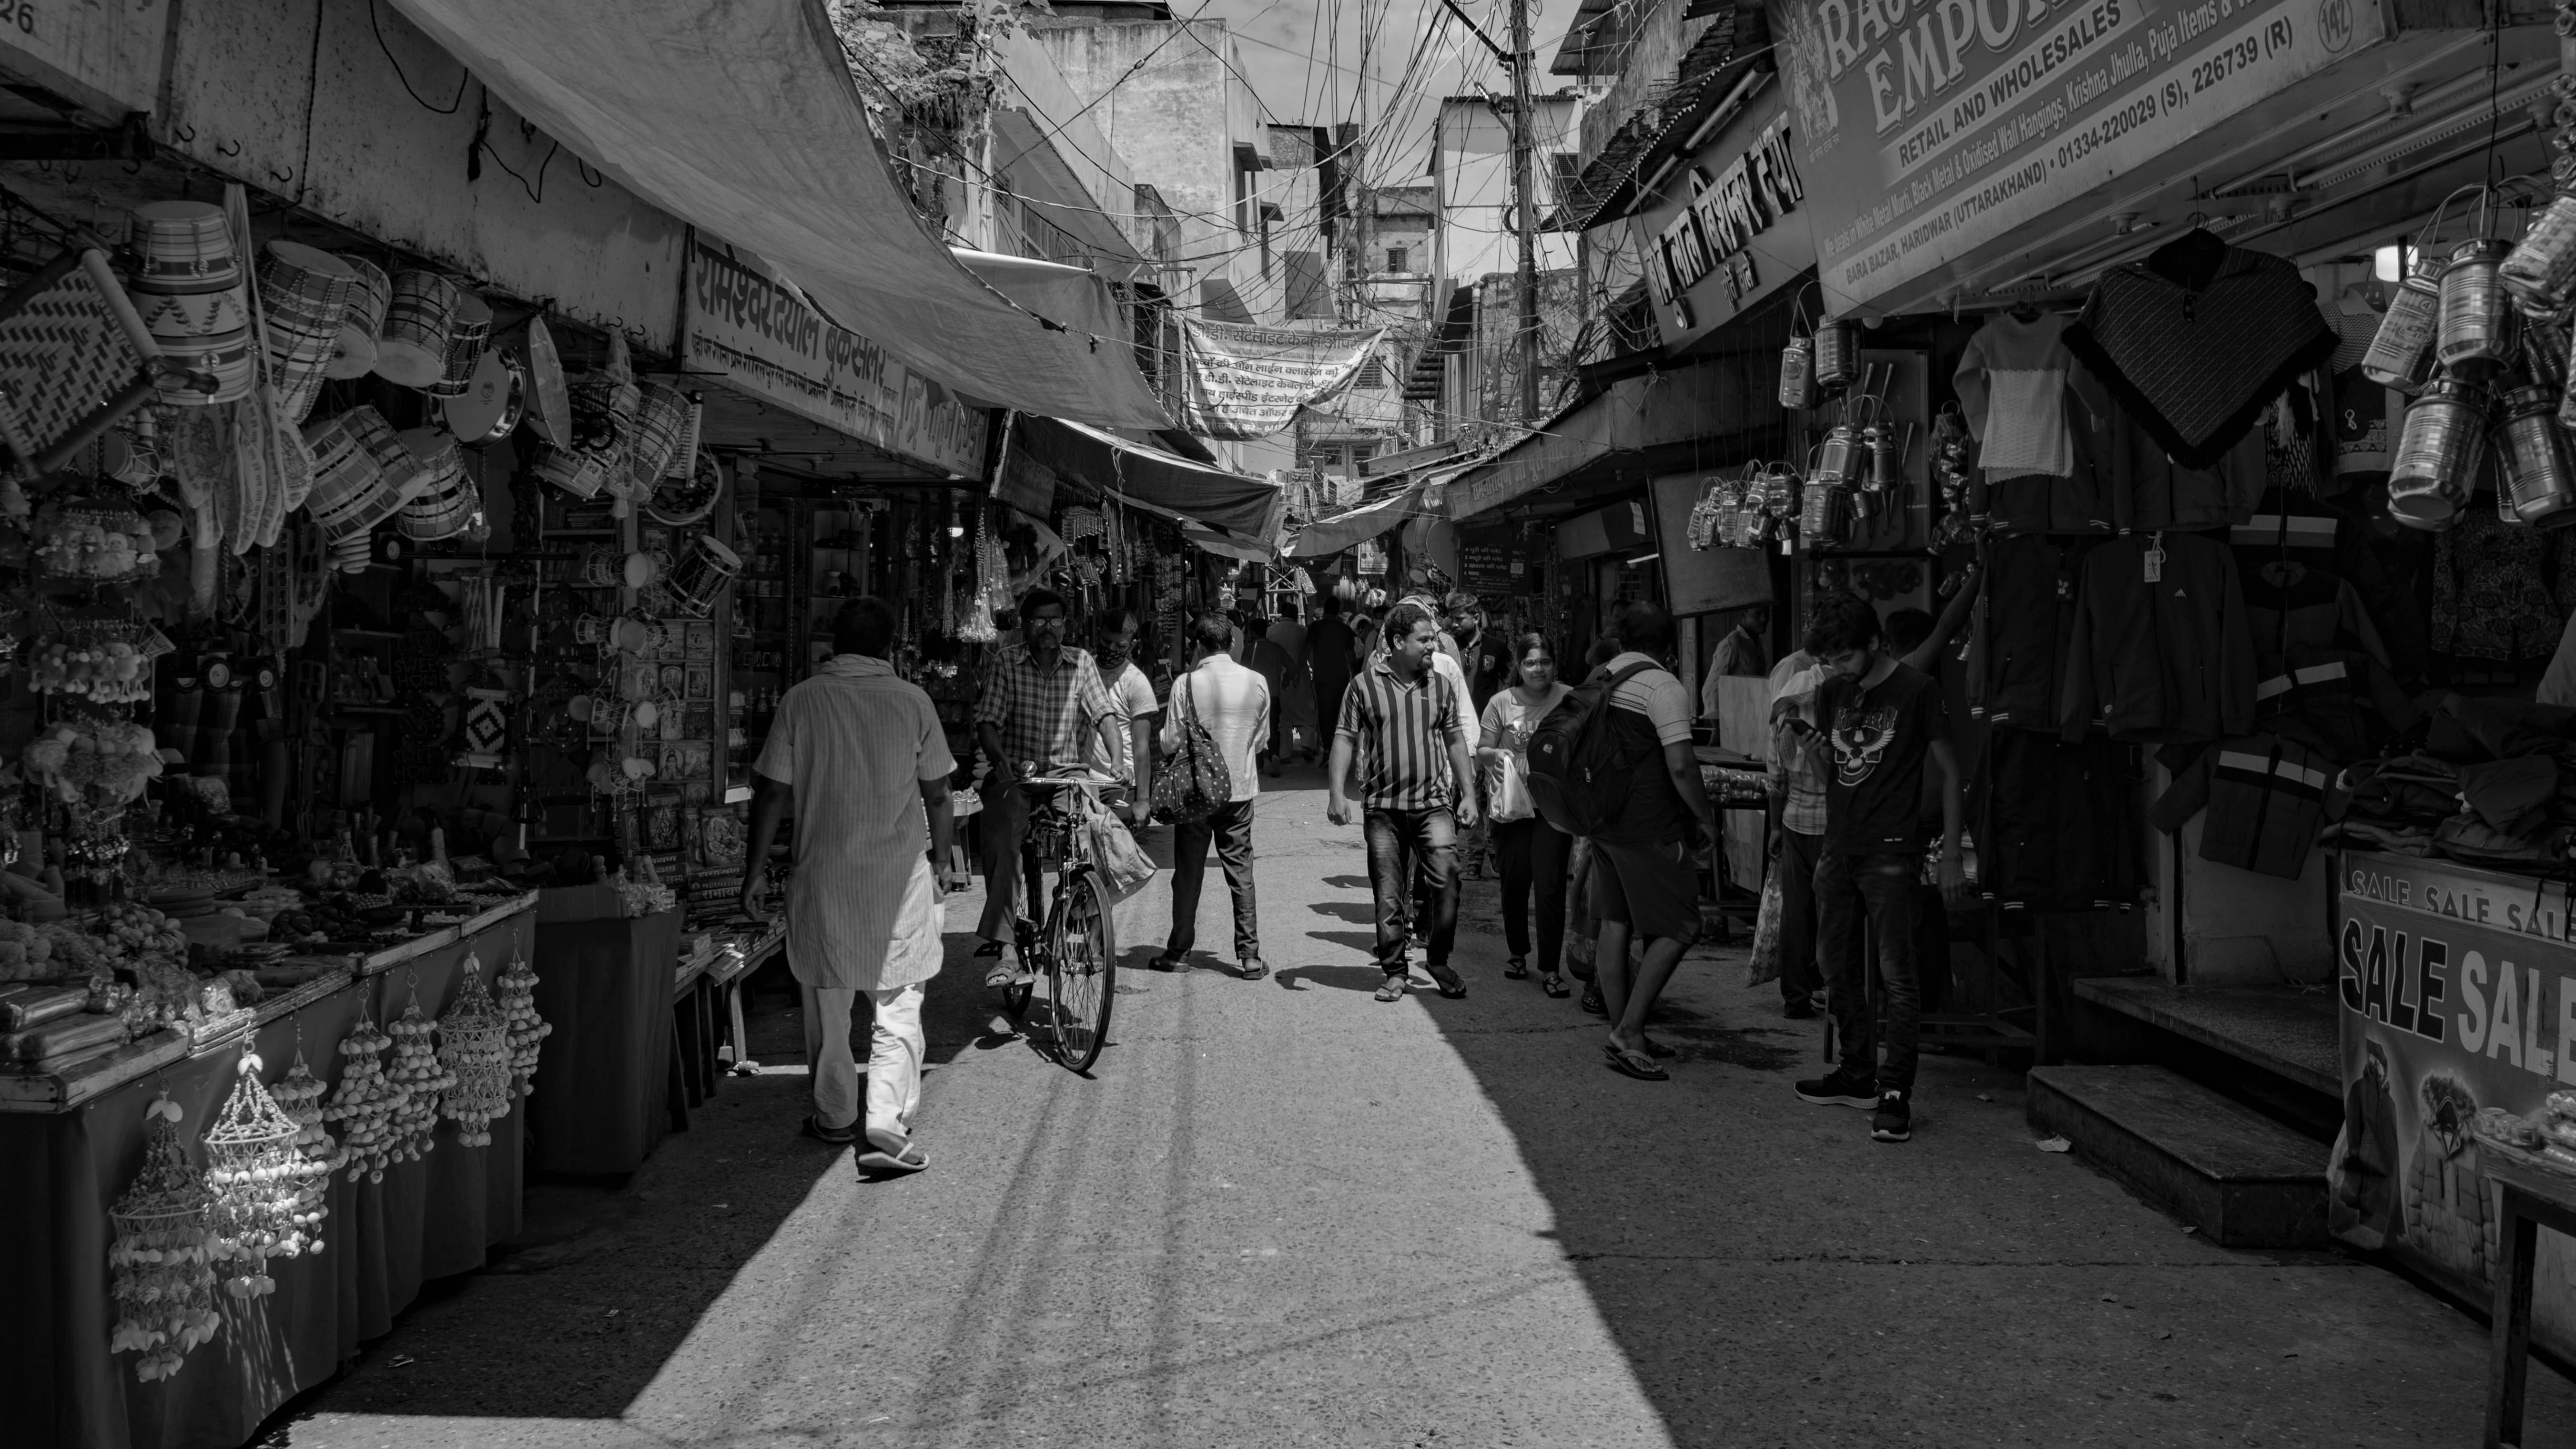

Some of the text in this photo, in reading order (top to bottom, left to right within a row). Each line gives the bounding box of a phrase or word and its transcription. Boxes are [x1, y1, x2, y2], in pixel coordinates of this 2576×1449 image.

[2322, 0, 2349, 44] 142
[1865, 0, 2069, 135] EMPO
[1899, 0, 2121, 168] RETAIL AND WHOLESALES
[1824, 237, 1835, 259] We
[1834, 228, 1851, 255] deals
[1850, 225, 1857, 245] in
[1856, 214, 1874, 242] White
[1873, 205, 1893, 233] Metal
[1911, 178, 1932, 208] Black
[1932, 163, 1955, 193] Metal
[1954, 155, 1963, 180] &
[1962, 137, 1999, 177] Oxidised
[2000, 120, 2021, 156] Wall
[2019, 96, 2068, 142] Hangings,
[2066, 67, 2109, 114] Krishna
[2109, 40, 2150, 88] Jhulla,
[2148, 20, 2178, 65] Puja
[2177, 1, 2219, 45] Items
[1846, 15, 2293, 286] BARA BAZAR, HARIDWAR (UTTARAKHAND) 01334-220029 (S), 226739 (R)
[1233, 326, 1285, 346] सेटेलाइट
[1324, 333, 1370, 352] ओपरेट
[1235, 375, 1275, 388] सेटेलाइट
[1277, 378, 1304, 390] केबल
[1256, 363, 1283, 374] लाईन
[394, 657, 439, 673] SWEE
[2352, 870, 2411, 907] SALE
[2424, 886, 2491, 924] SALE
[2340, 918, 2576, 1086] SALE SALE
